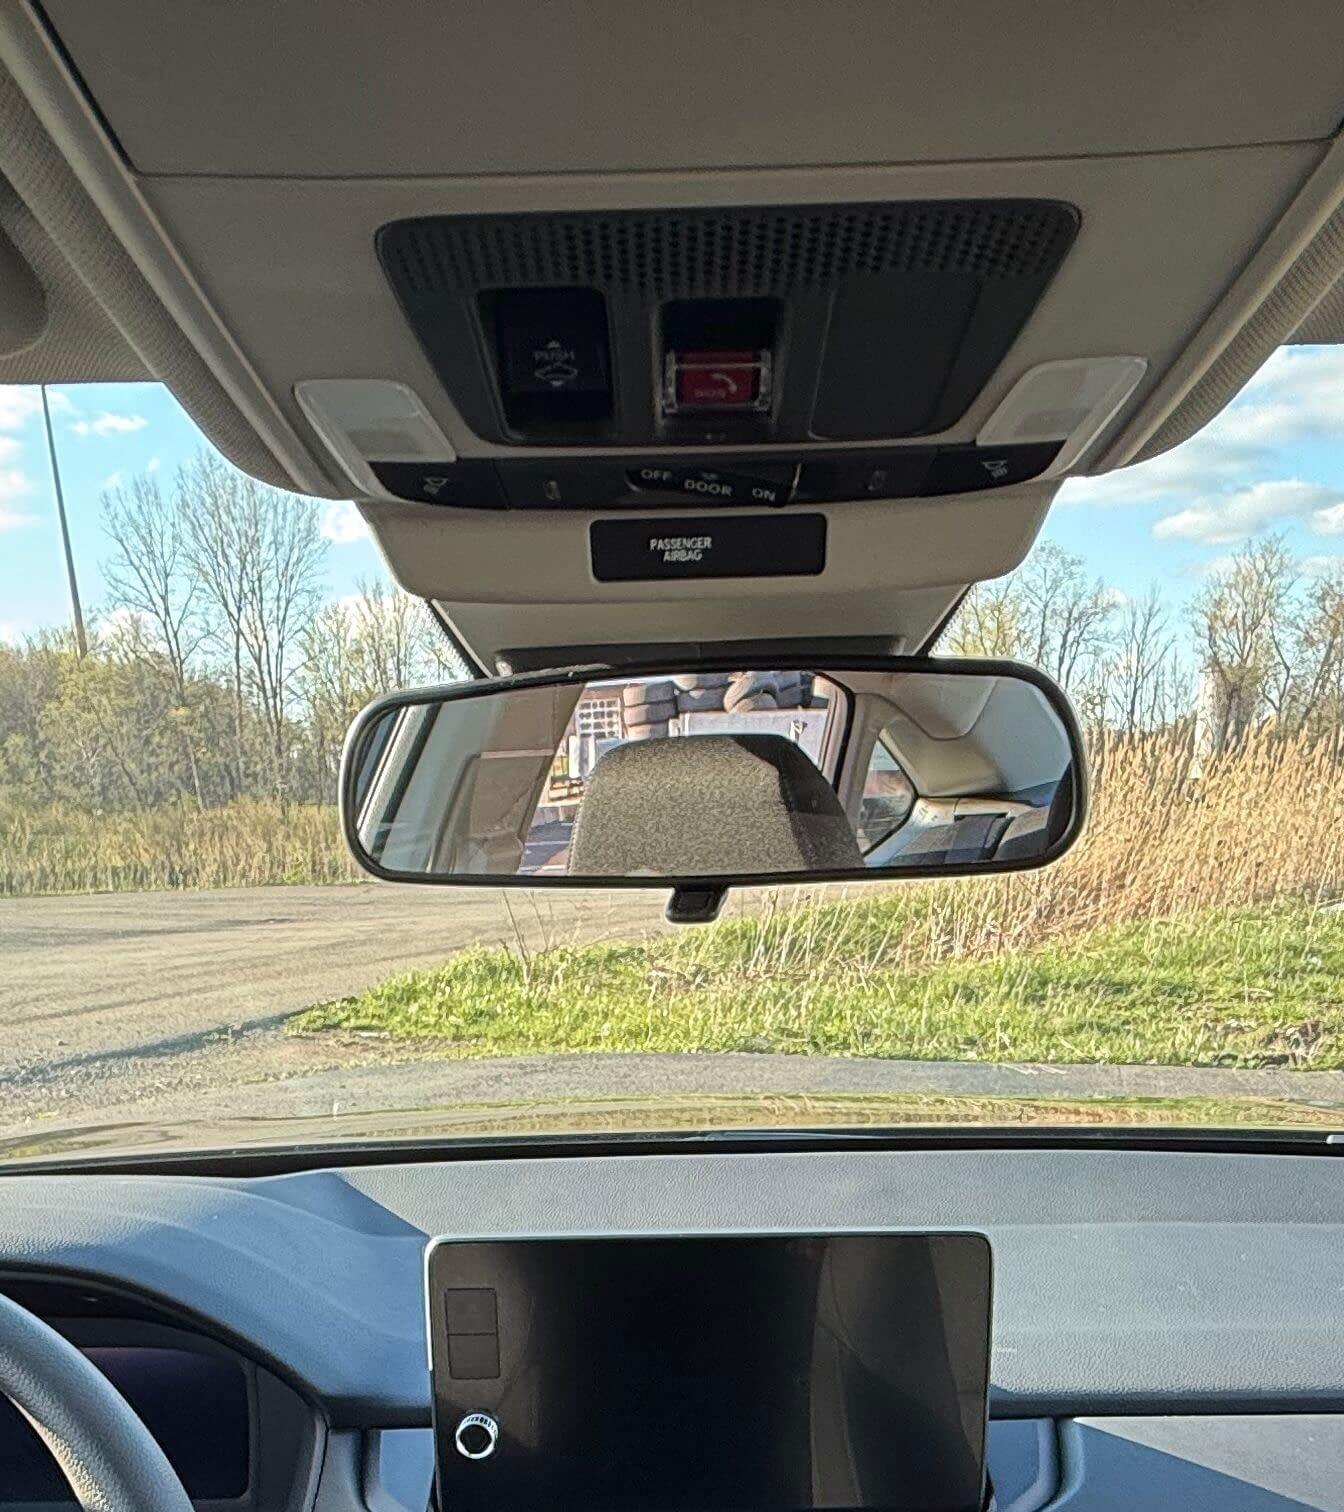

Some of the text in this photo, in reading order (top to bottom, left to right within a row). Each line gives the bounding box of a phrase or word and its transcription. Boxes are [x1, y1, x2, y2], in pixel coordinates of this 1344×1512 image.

[640, 469, 672, 480] OFF
[684, 479, 733, 496] DOOR
[751, 487, 776, 501] ON
[649, 537, 712, 551] PASSENGER
[663, 549, 703, 562] AIRBAG
